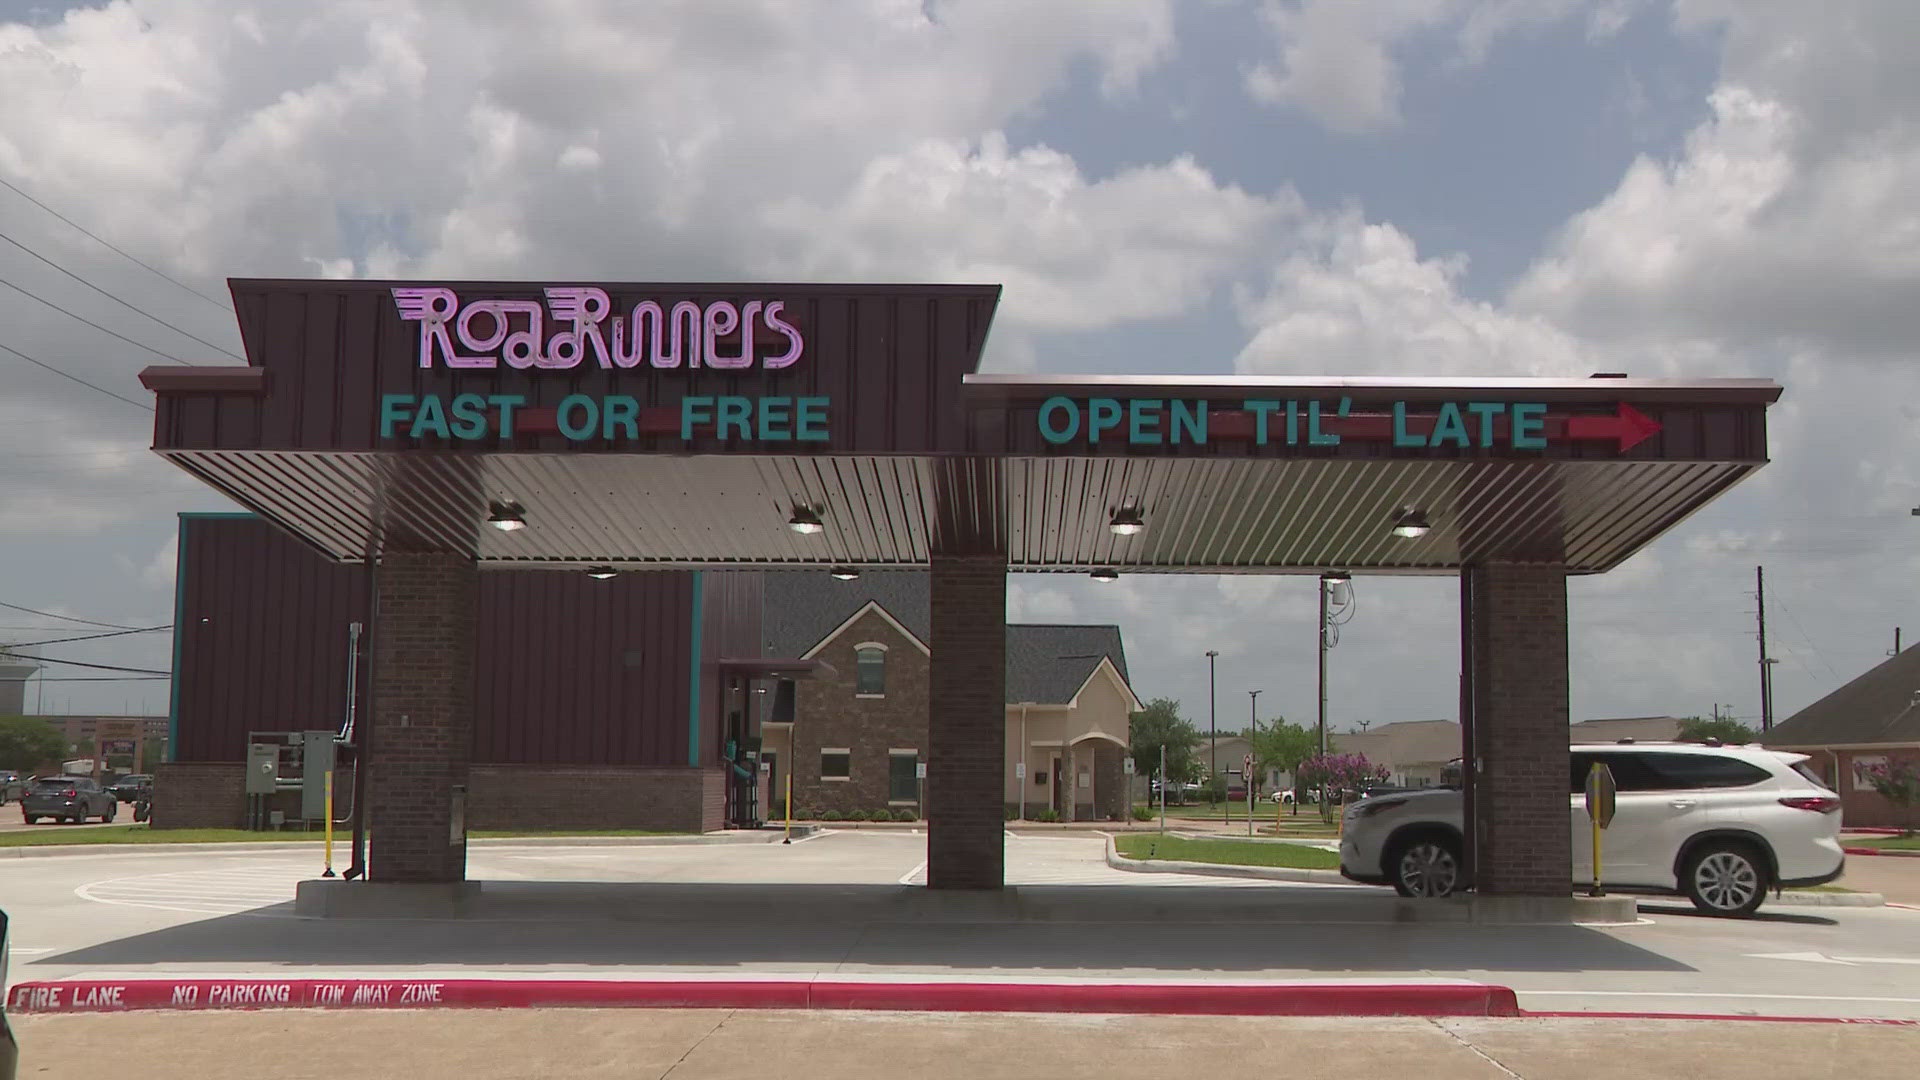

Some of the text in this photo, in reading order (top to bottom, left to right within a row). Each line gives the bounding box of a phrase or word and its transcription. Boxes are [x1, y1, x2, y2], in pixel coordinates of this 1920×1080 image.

[380, 394, 831, 441] FAST OR FREE
[1037, 396, 1208, 445] OPEN
[1392, 400, 1549, 449] LATE
[15, 986, 125, 1008] FIRE LANE
[171, 984, 291, 1006] NO PARKING
[312, 984, 445, 1005] TOW AWAY ZONE
